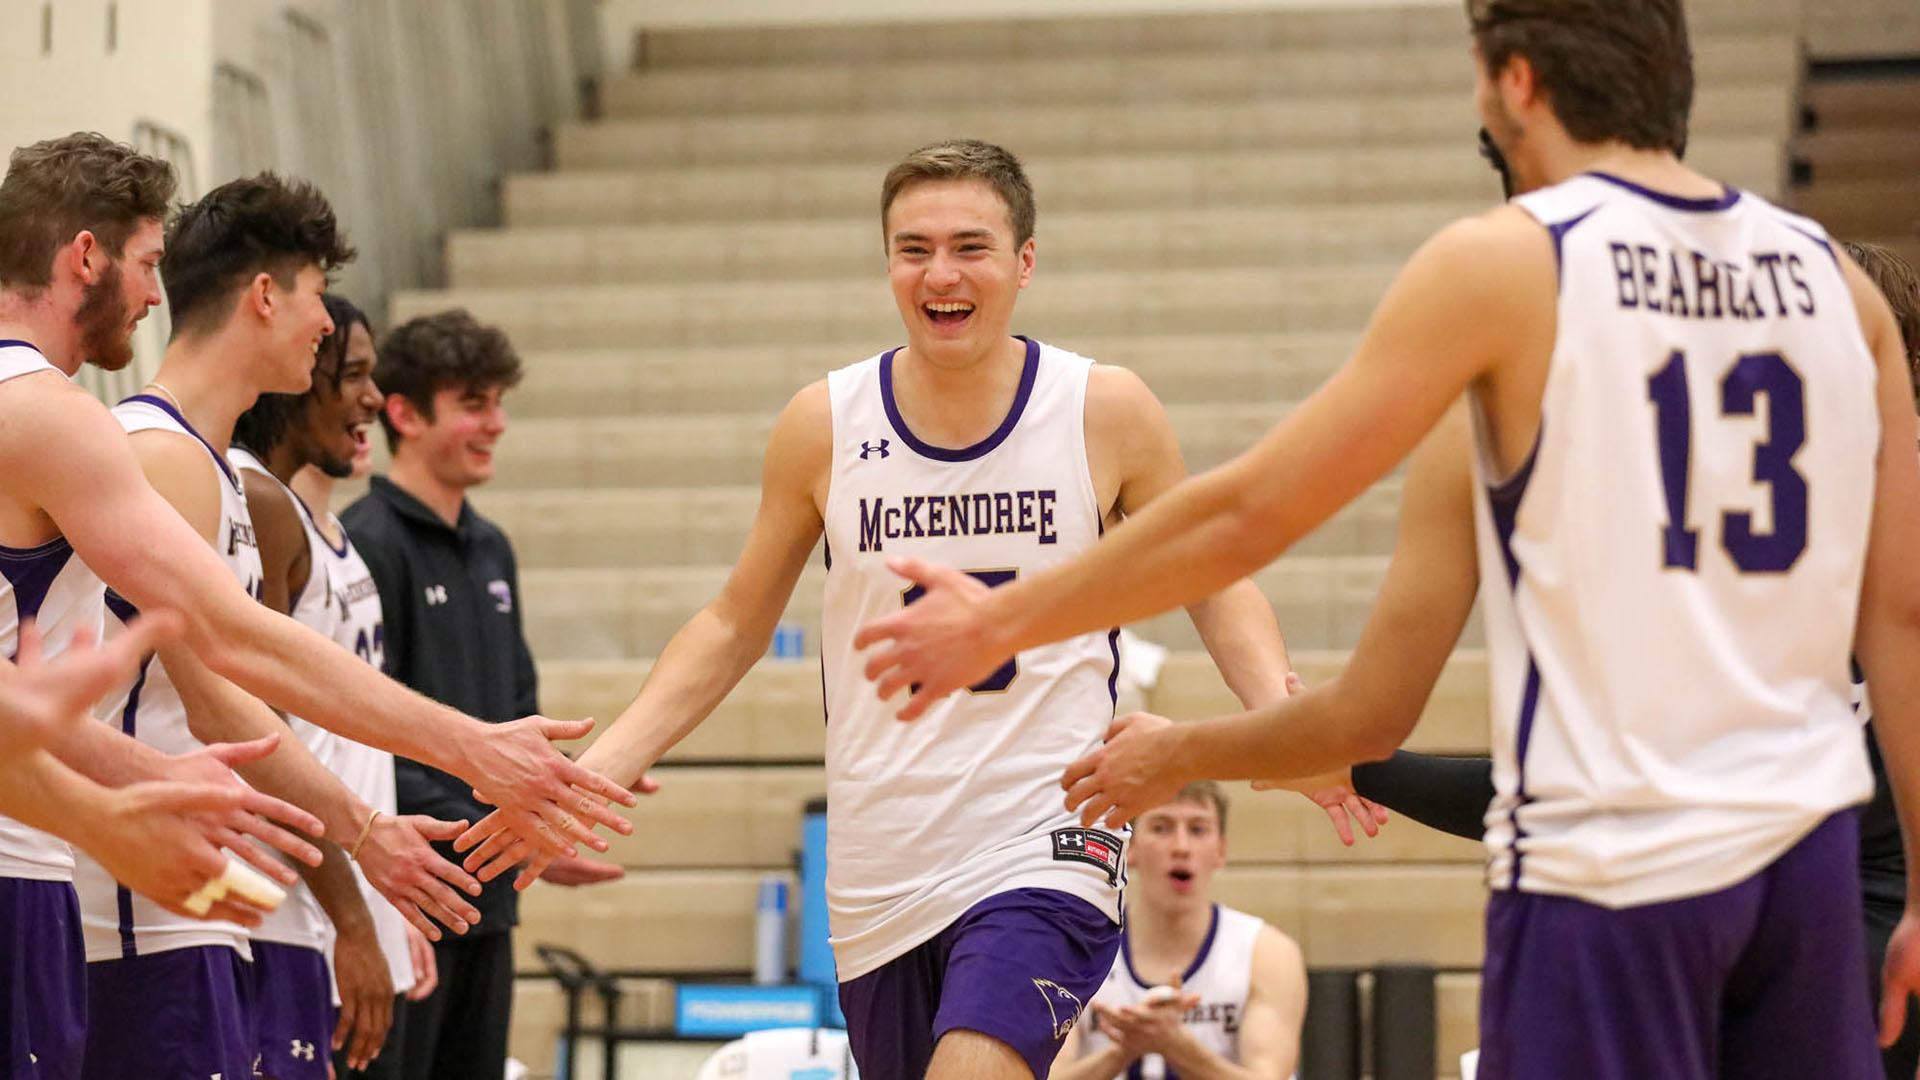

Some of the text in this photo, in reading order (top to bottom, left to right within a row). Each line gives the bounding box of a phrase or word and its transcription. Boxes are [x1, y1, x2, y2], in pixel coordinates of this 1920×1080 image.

[1609, 241, 1816, 319] BEARCATS
[1645, 348, 1810, 574] 13
[858, 489, 1057, 552] McKENDREE
